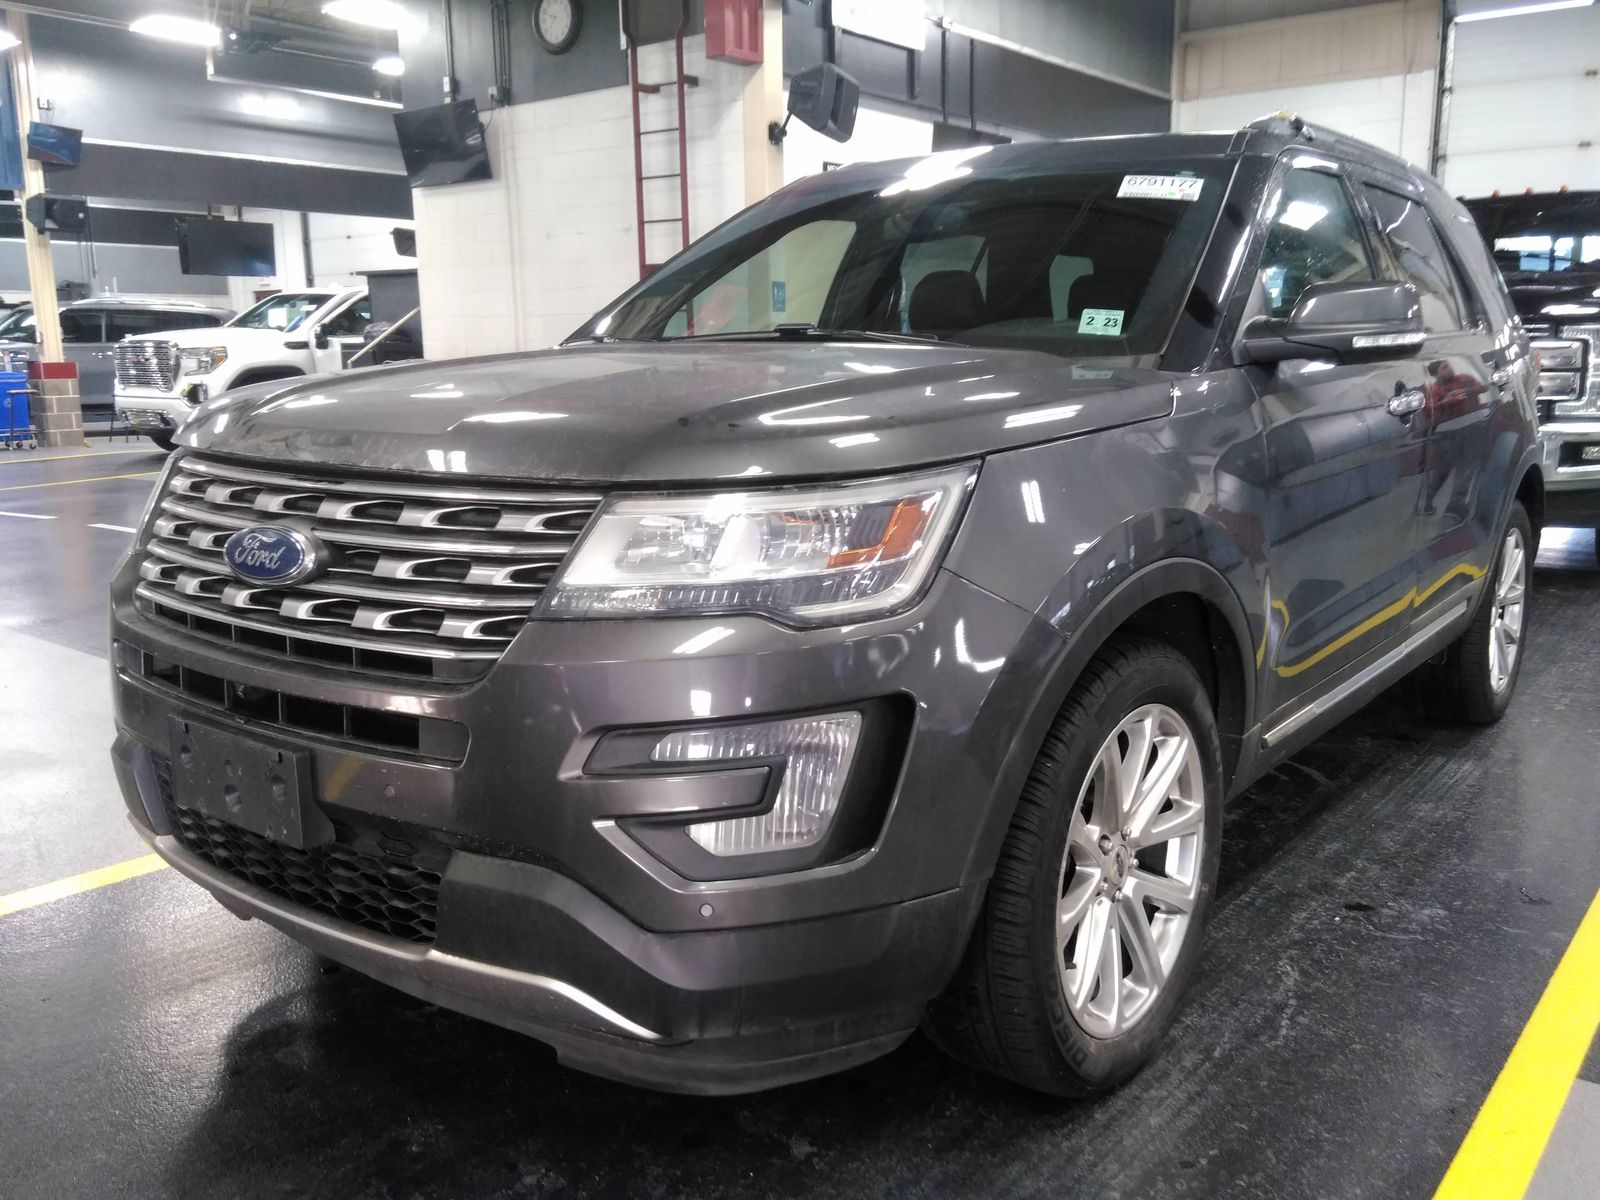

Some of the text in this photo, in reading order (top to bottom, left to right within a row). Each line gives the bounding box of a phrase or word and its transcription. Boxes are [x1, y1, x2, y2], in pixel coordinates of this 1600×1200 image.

[1127, 176, 1199, 188] 6791177
[1086, 316, 1119, 328] 2 23
[234, 533, 286, 570] Ford
